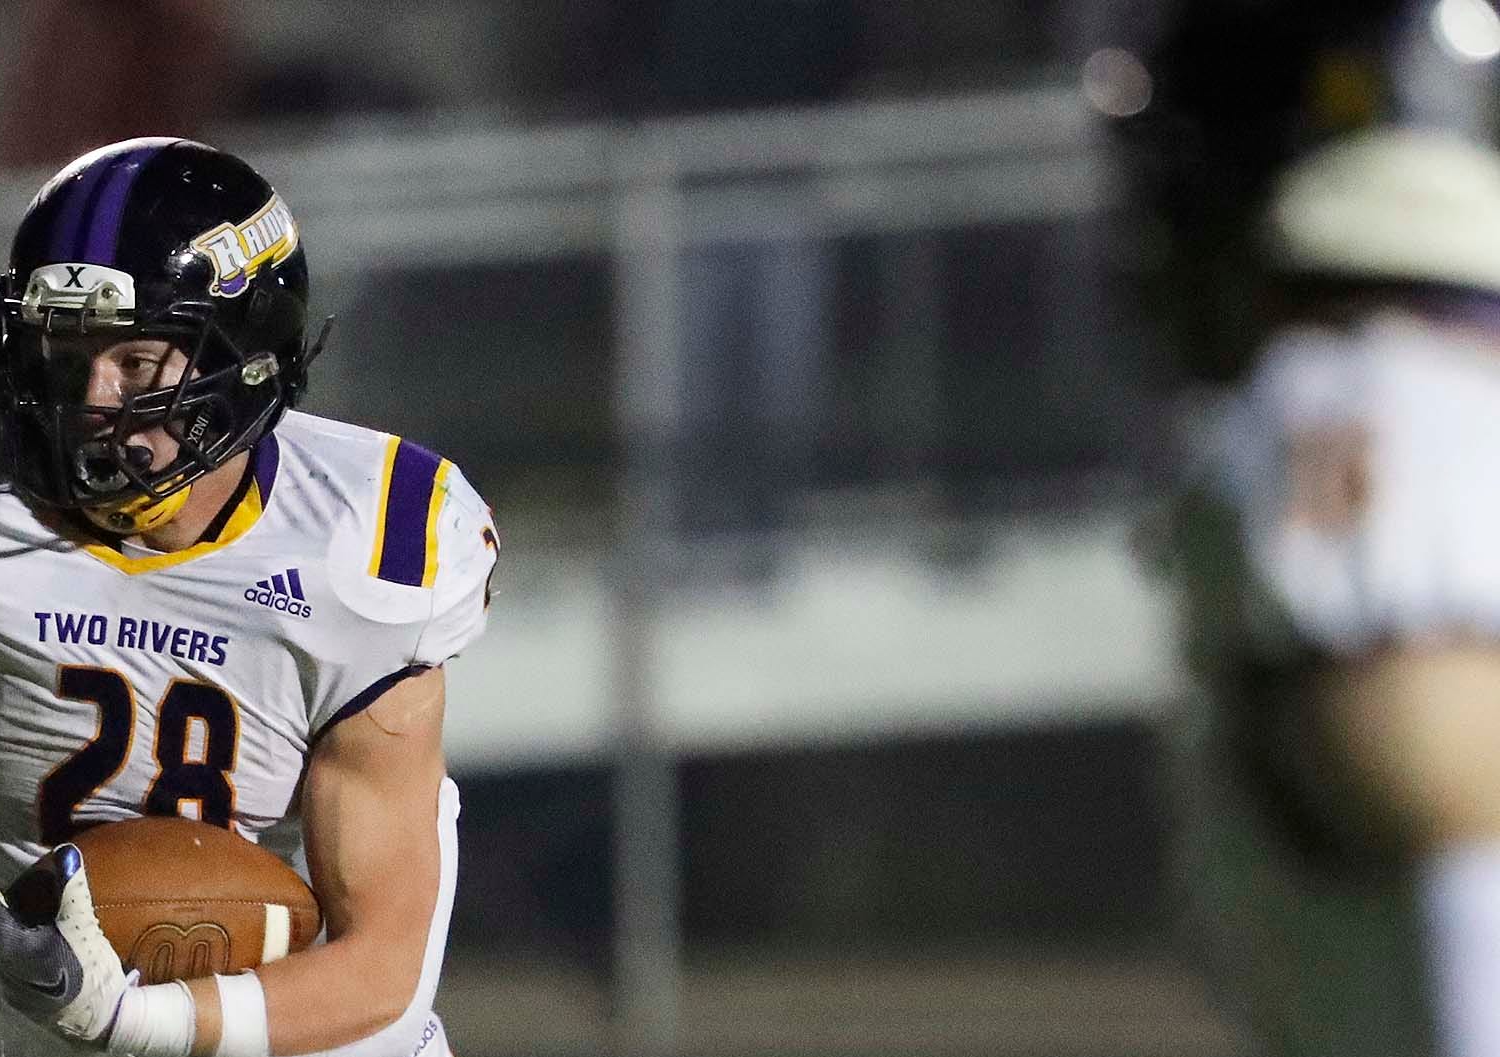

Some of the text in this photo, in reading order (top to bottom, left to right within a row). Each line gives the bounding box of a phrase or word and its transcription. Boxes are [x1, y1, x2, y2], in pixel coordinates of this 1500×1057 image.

[65, 266, 87, 289] X
[244, 588, 312, 618] adidas
[34, 612, 229, 667] TWO RIVERS
[38, 663, 241, 846] 28
